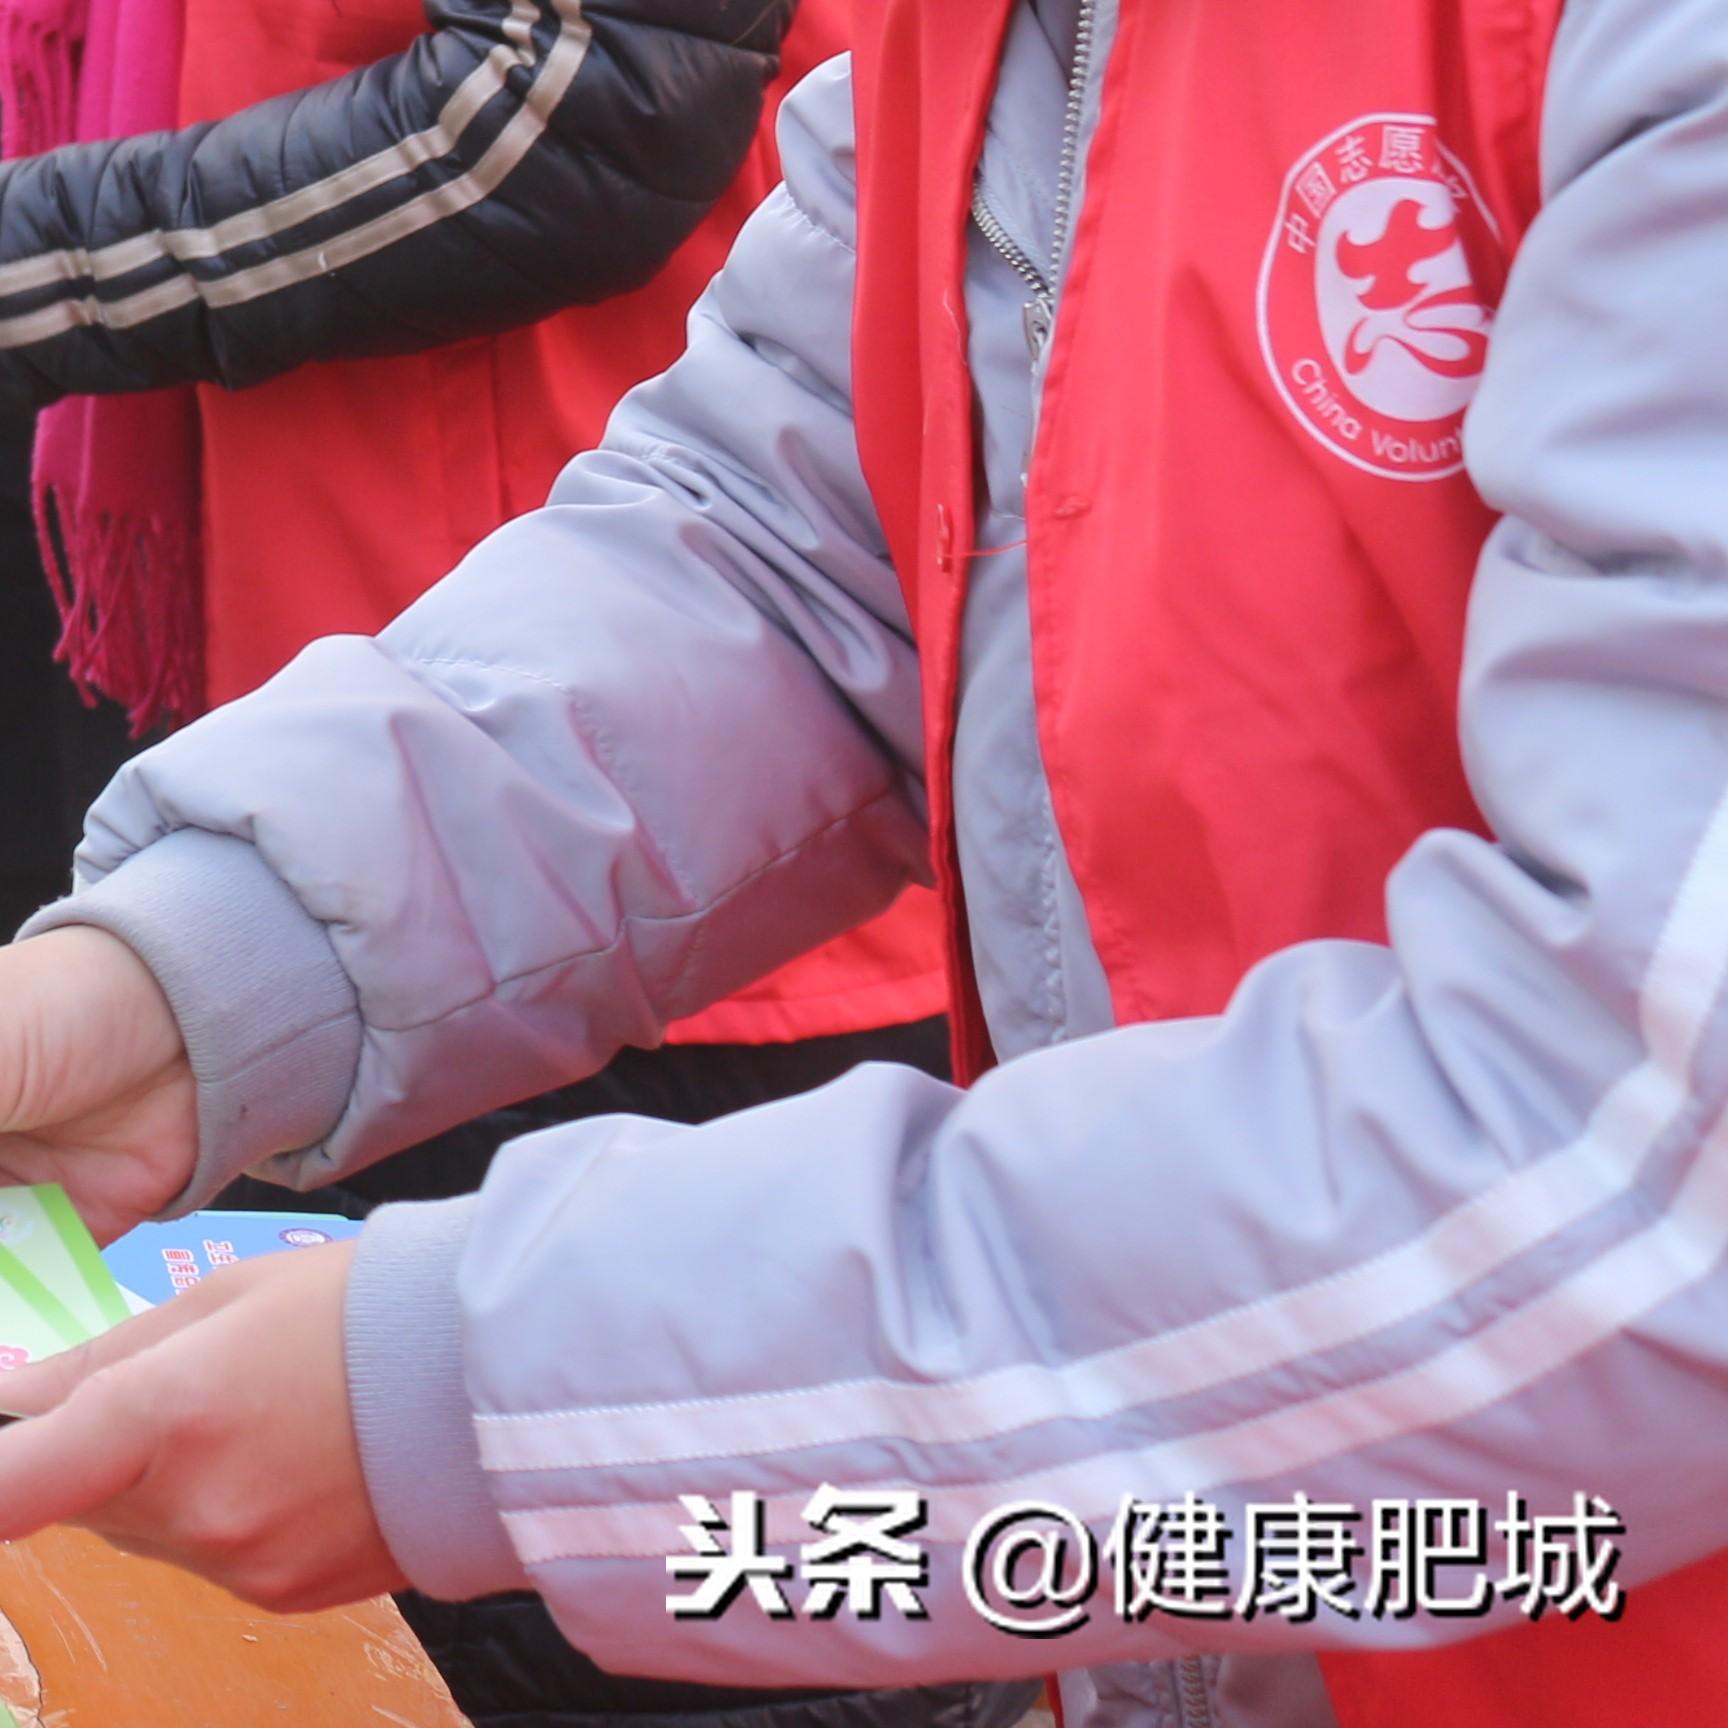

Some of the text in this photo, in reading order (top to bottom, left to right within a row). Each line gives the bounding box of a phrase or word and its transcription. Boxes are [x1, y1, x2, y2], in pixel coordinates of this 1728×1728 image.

[1285, 124, 1467, 254] 中国志愿
[1292, 357, 1462, 464] China Volun
[161, 1248, 201, 1294] 宣传分
